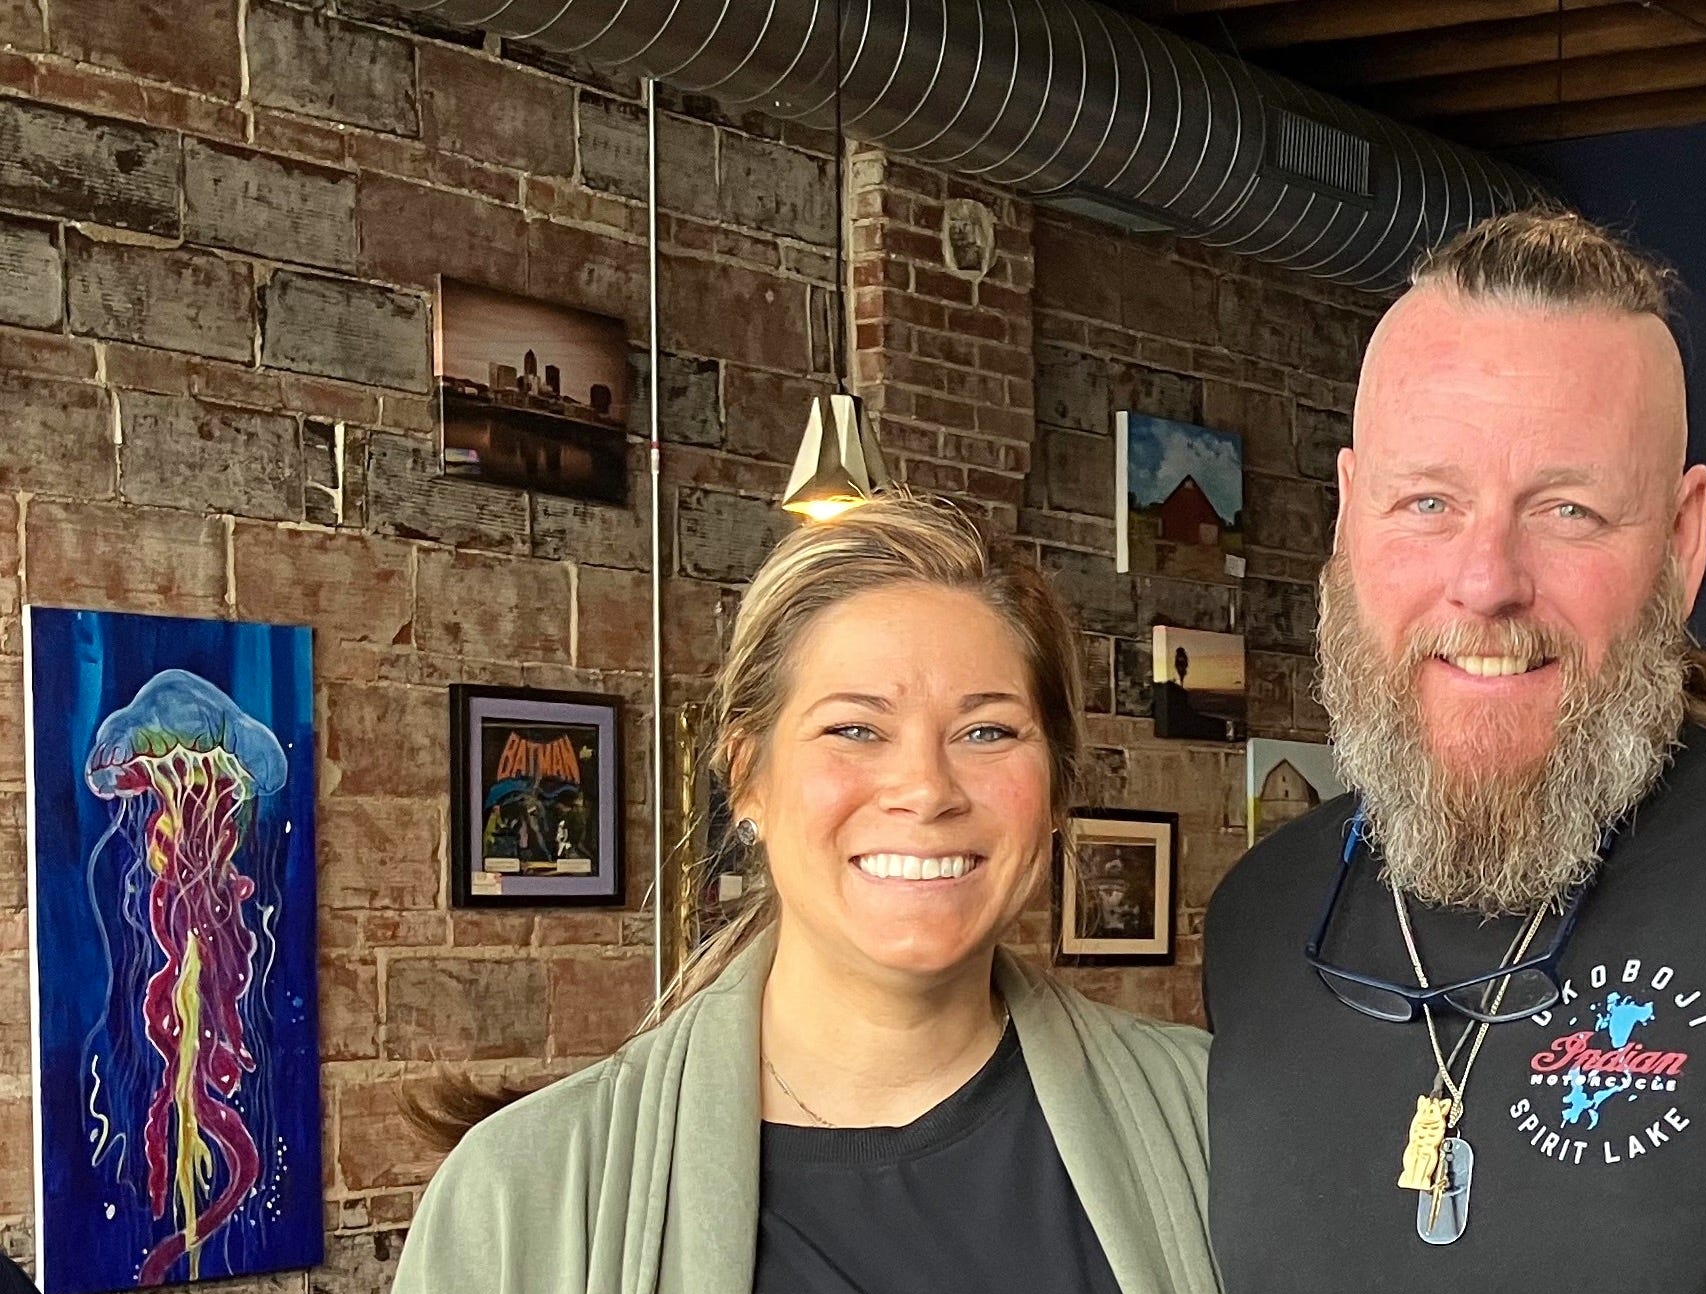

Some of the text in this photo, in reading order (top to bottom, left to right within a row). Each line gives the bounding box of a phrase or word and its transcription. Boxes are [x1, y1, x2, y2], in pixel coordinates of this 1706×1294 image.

[496, 731, 582, 784] BATMAN
[1530, 1031, 1688, 1075] Indian
[1530, 1073, 1677, 1092] MOTORCYCLE
[1509, 1098, 1690, 1165] SPIRIT LAKE
